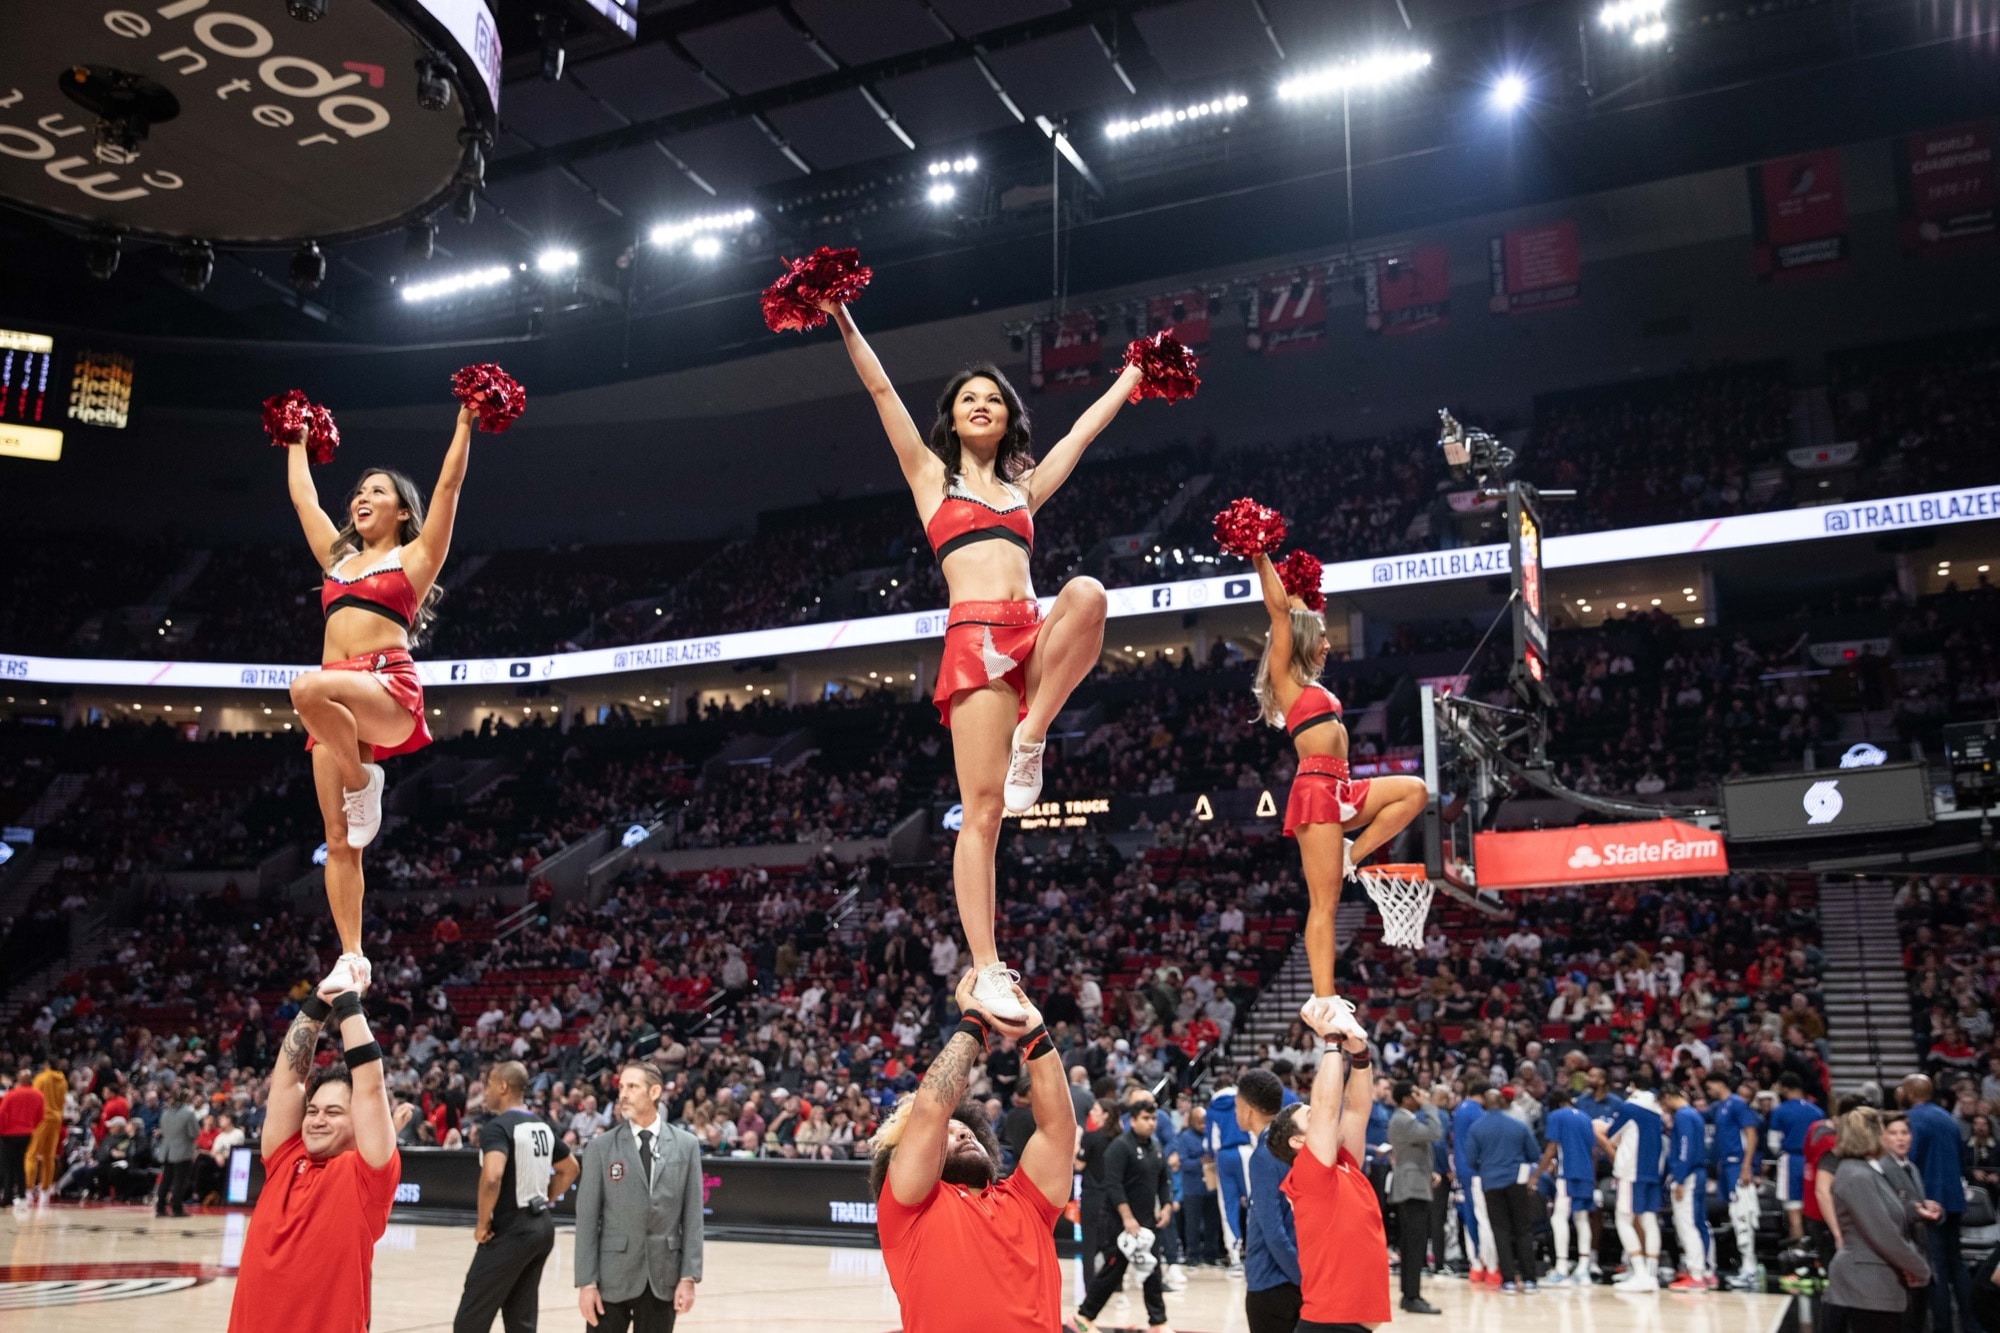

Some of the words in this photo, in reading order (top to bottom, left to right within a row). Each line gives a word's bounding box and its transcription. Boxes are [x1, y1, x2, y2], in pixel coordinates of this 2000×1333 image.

[157, 0, 390, 138] oda
[71, 374, 131, 400] ripcity
[69, 389, 129, 415] ripcity
[67, 402, 128, 429] ripcity
[1373, 549, 1512, 583] @TRAILBLAZE
[614, 641, 721, 667] @TRAILBLAZERS
[1064, 799, 1110, 814] TRUCK
[532, 1130, 549, 1157] 30
